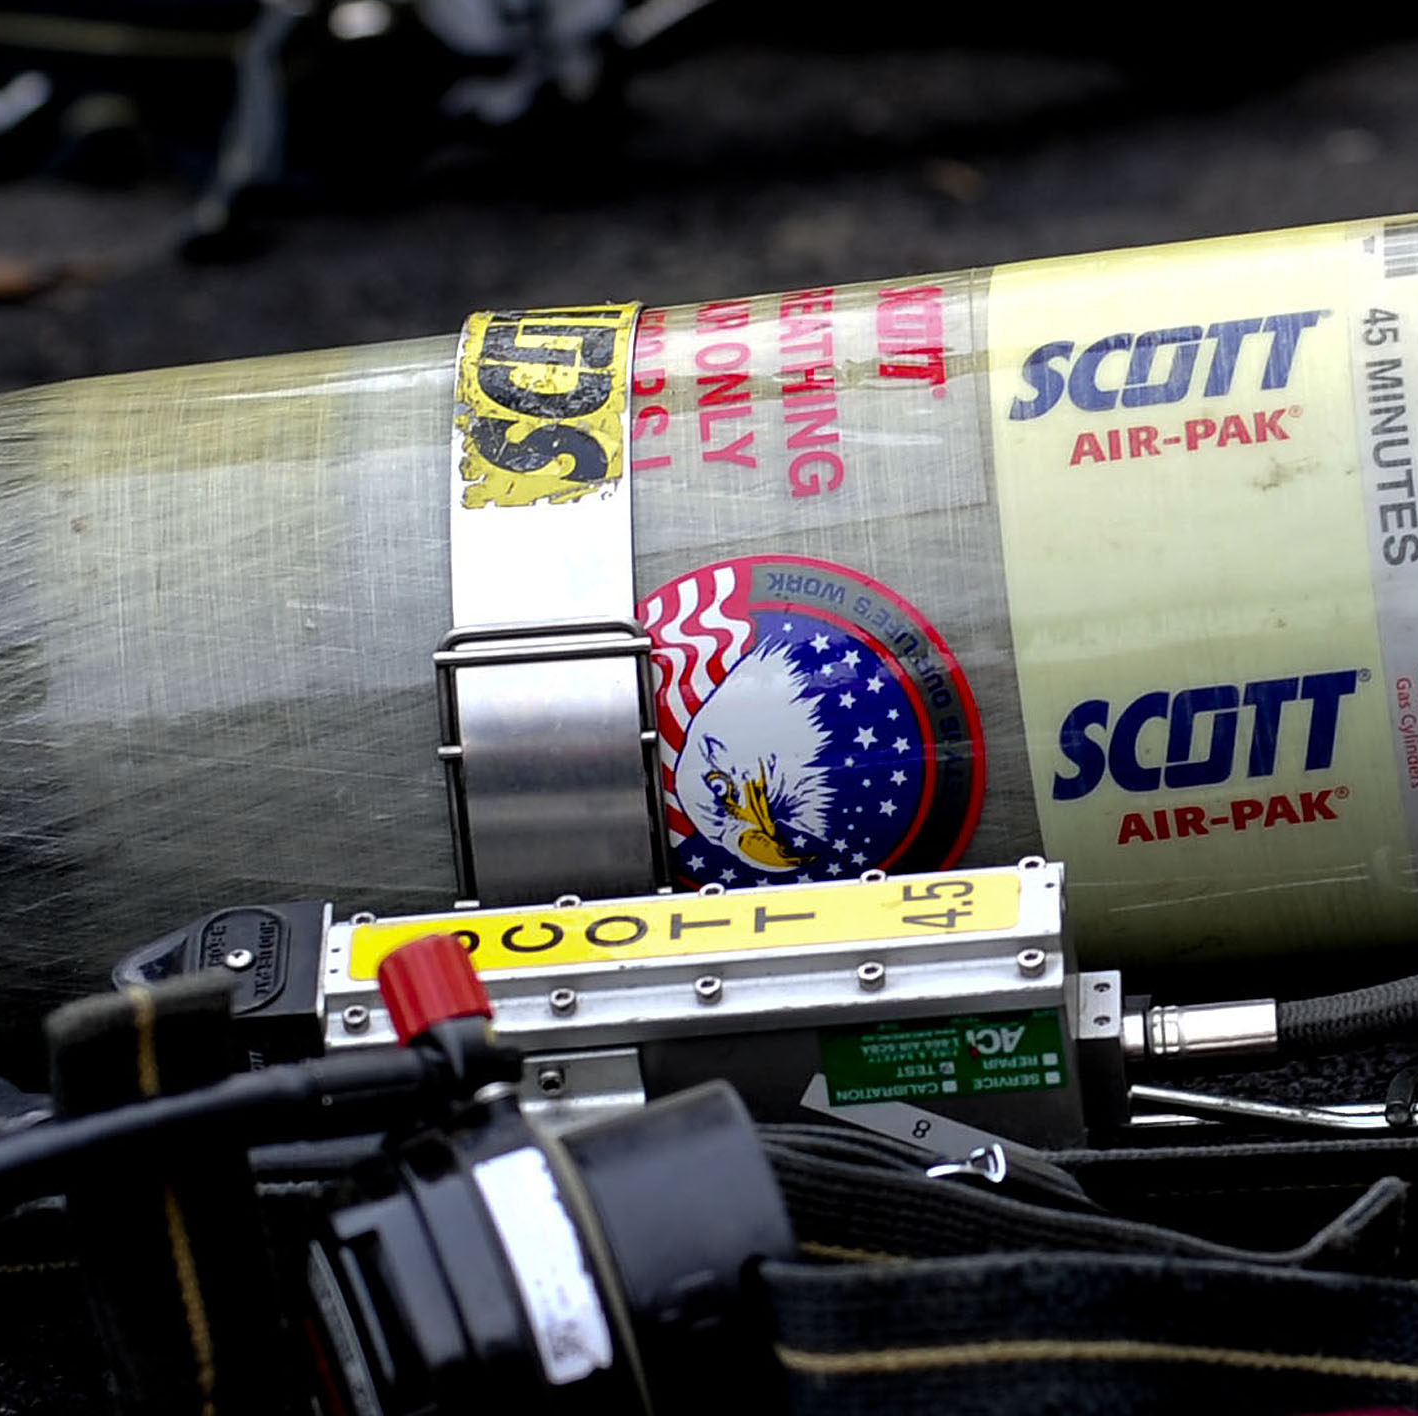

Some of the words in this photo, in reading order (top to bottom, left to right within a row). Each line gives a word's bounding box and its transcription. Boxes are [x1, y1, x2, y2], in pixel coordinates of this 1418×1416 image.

[1361, 306, 1402, 347] 45
[1009, 309, 1321, 421] SCOTT
[697, 342, 757, 469] ONLY
[1069, 407, 1292, 466] AIR-PAK
[766, 572, 847, 604] WORK
[1396, 676, 1414, 709] Gas
[1053, 669, 1359, 801] SCOTT
[1117, 791, 1338, 845] AIR-PAK
[902, 880, 974, 931] 4.5
[895, 1063, 936, 1078] TEST
[981, 1055, 1039, 1070] REPAIR
[836, 1080, 939, 1102] CALIBRATION
[972, 1073, 1040, 1090] SERVICE
[911, 1119, 932, 1139] 8
